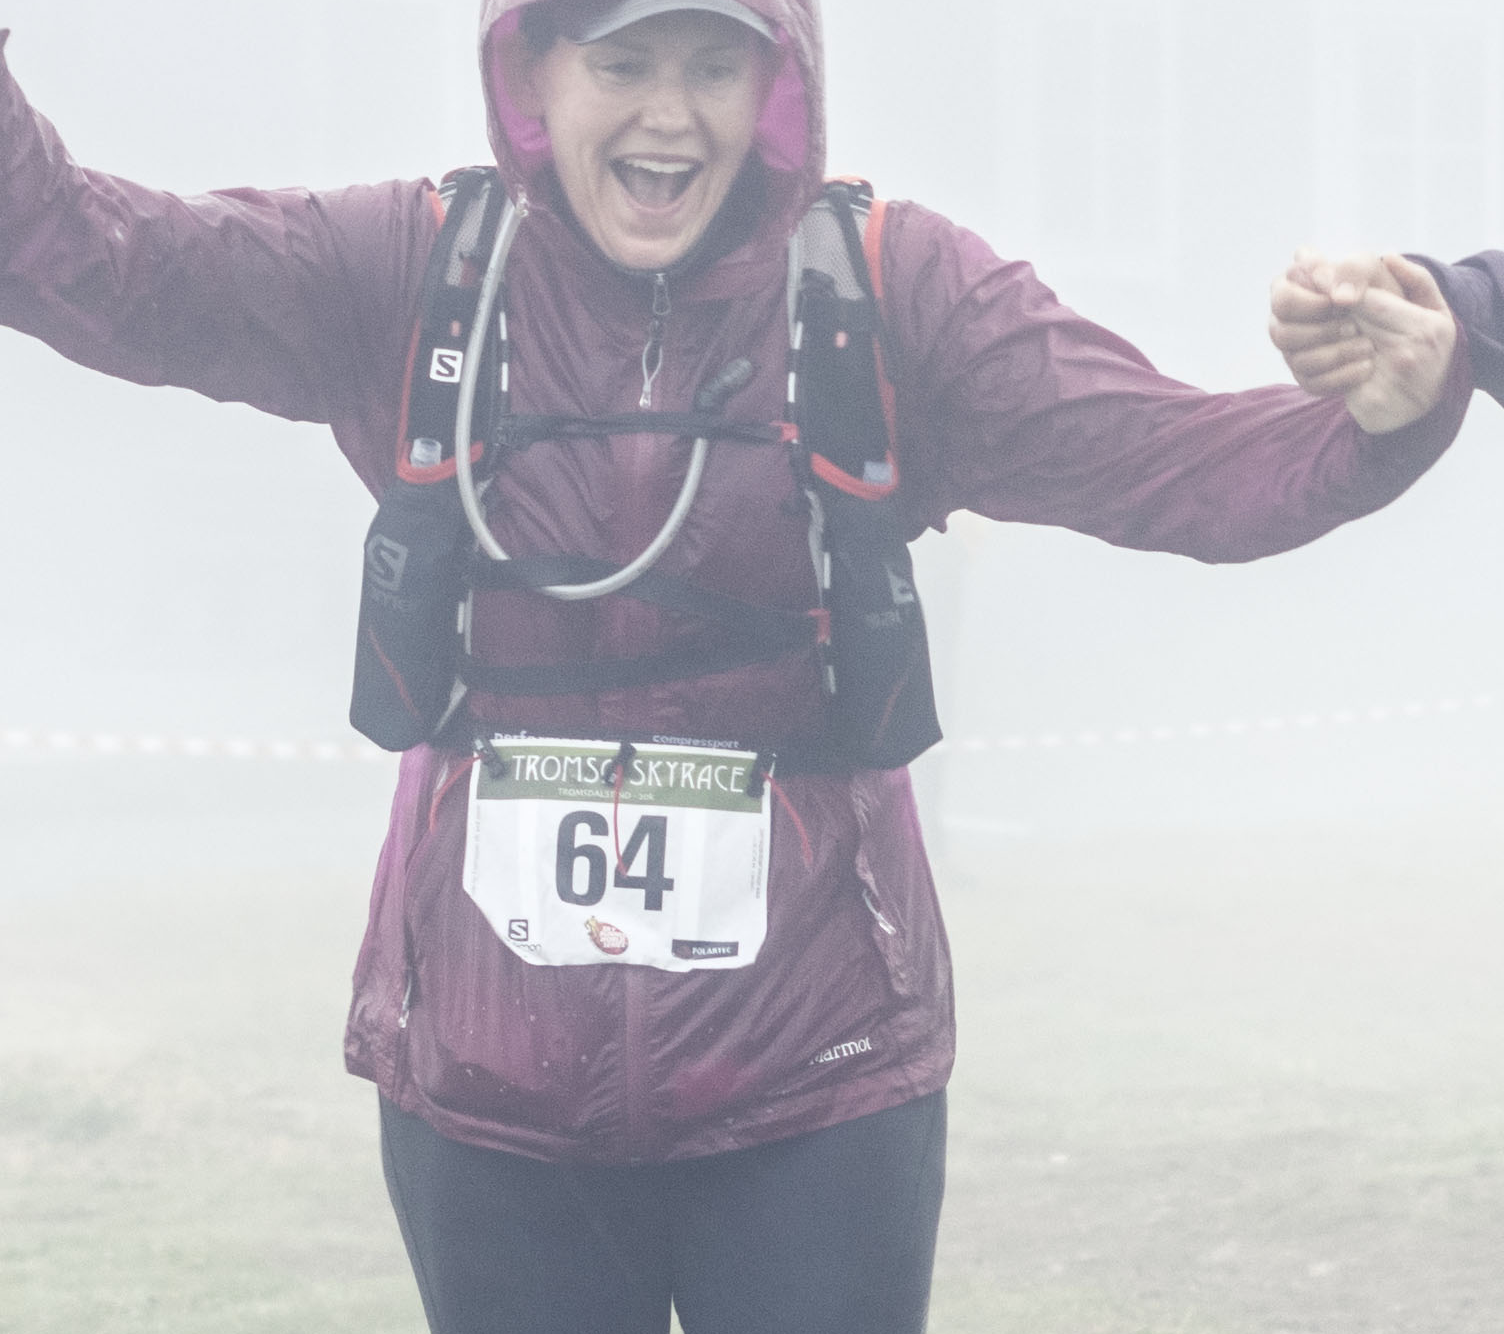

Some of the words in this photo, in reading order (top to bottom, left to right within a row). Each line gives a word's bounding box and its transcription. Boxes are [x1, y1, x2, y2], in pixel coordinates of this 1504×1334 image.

[558, 787, 631, 799] TROMSDALSTND
[630, 759, 745, 794] SKYRACE
[556, 810, 674, 911] 64
